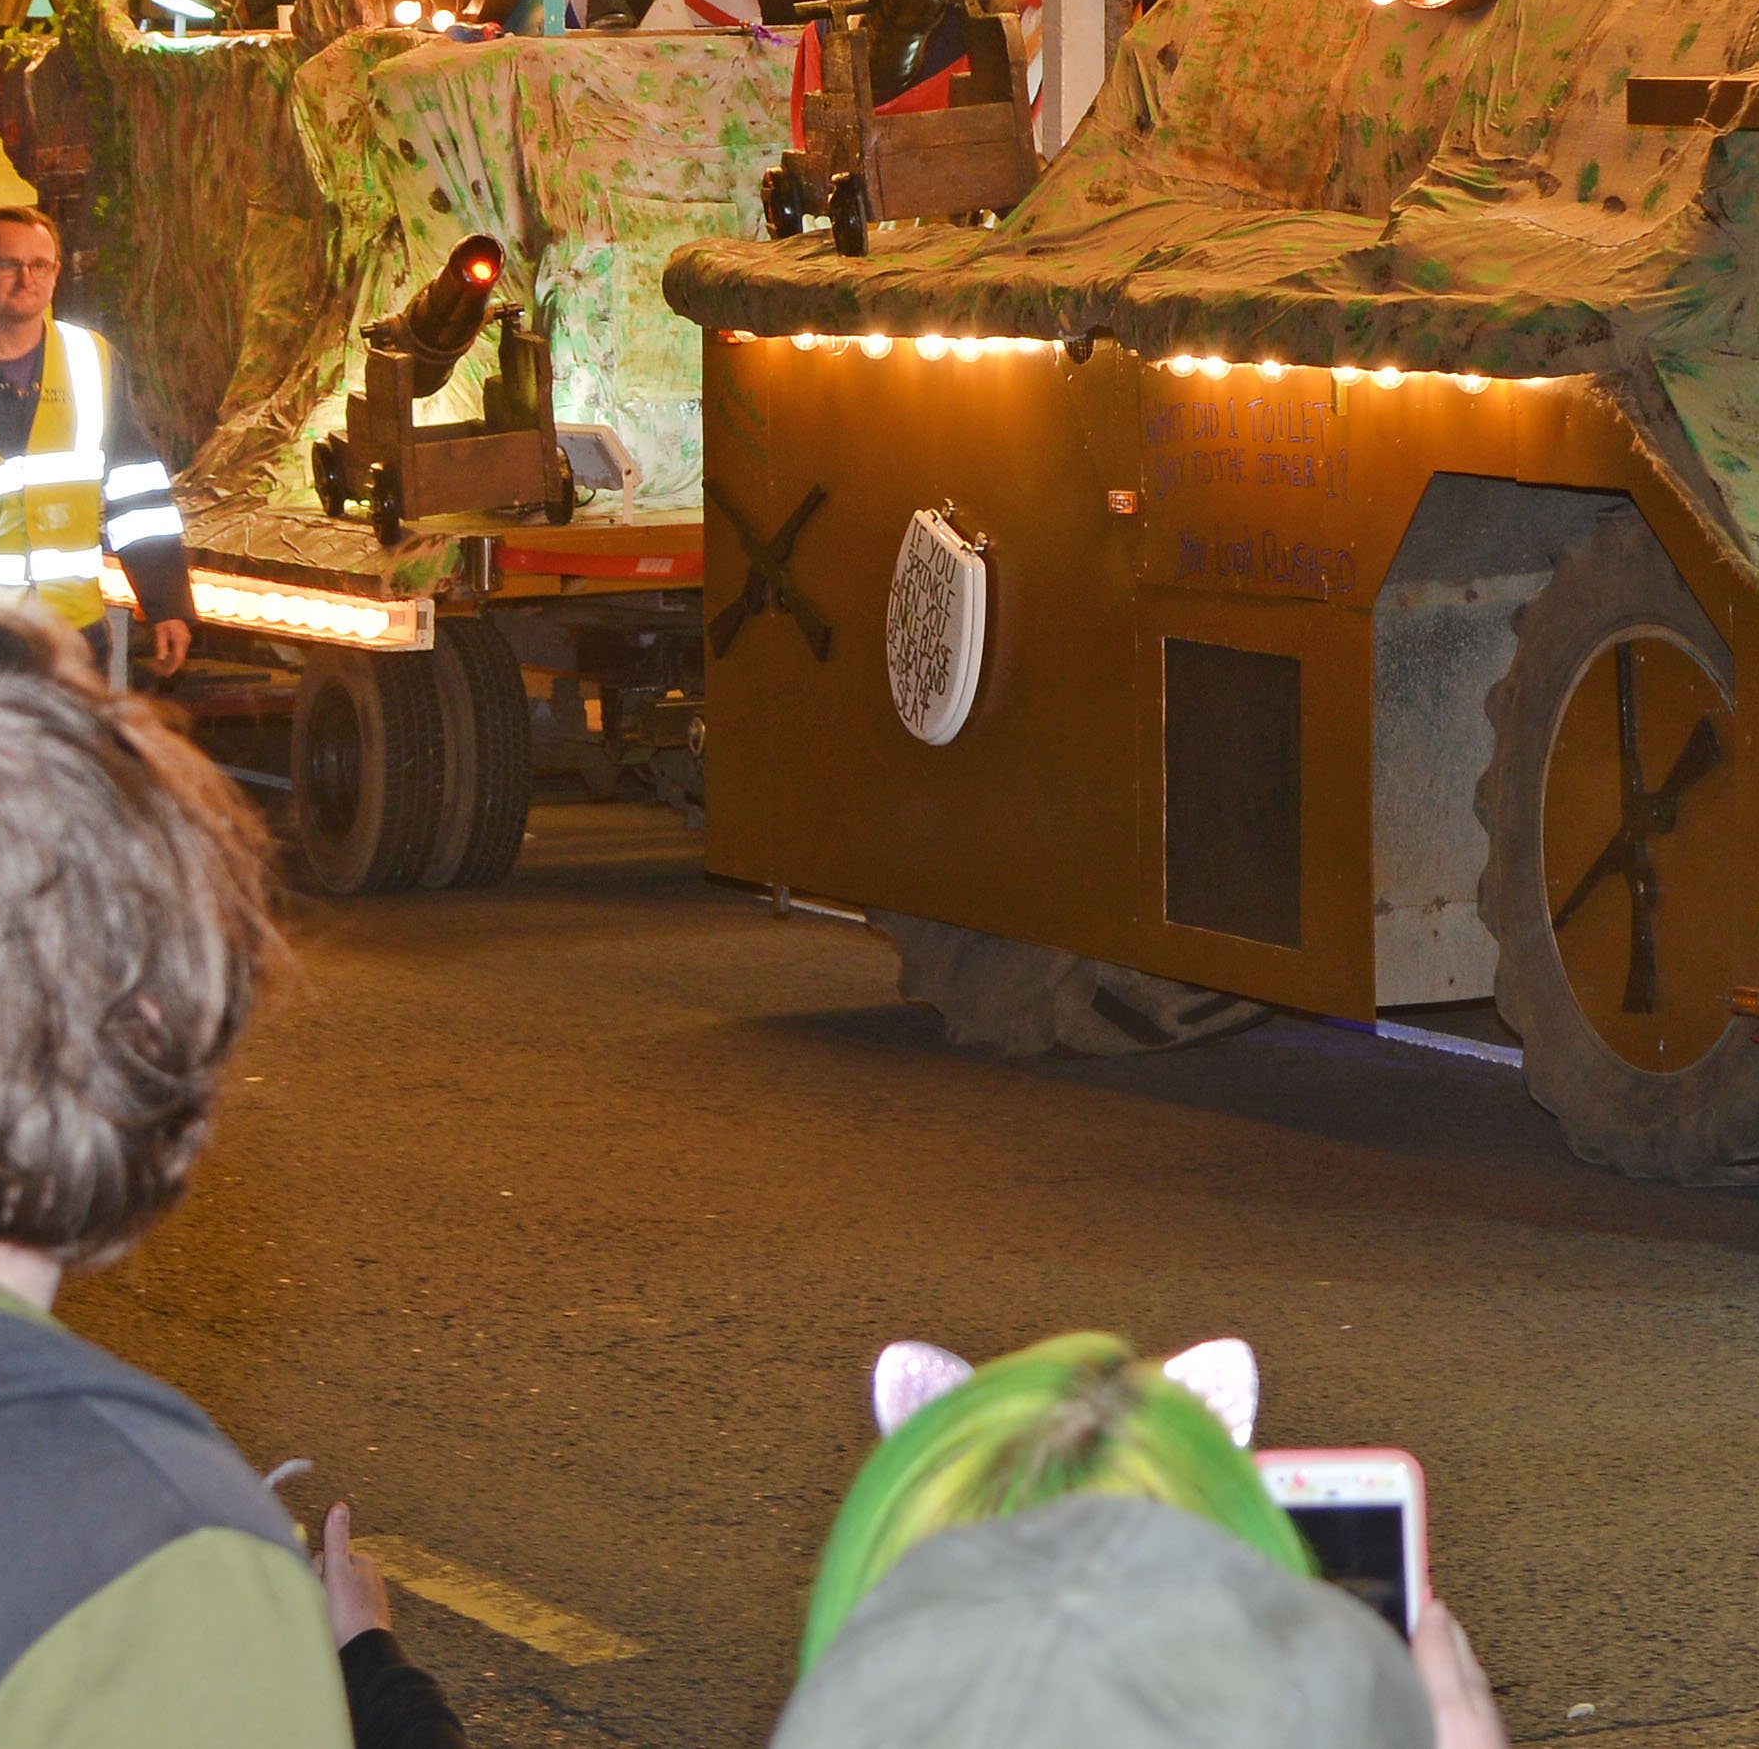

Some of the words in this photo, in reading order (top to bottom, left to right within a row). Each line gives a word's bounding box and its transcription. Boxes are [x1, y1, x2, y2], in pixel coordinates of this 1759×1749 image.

[1192, 402, 1220, 440] DID
[1247, 398, 1332, 450] TOILET
[1256, 453, 1316, 487] OTHER
[911, 517, 927, 552] IF
[928, 534, 958, 584] YOU
[904, 549, 956, 618] SPRINKLE
[922, 599, 948, 638] YOU
[896, 680, 930, 730] SEAT
